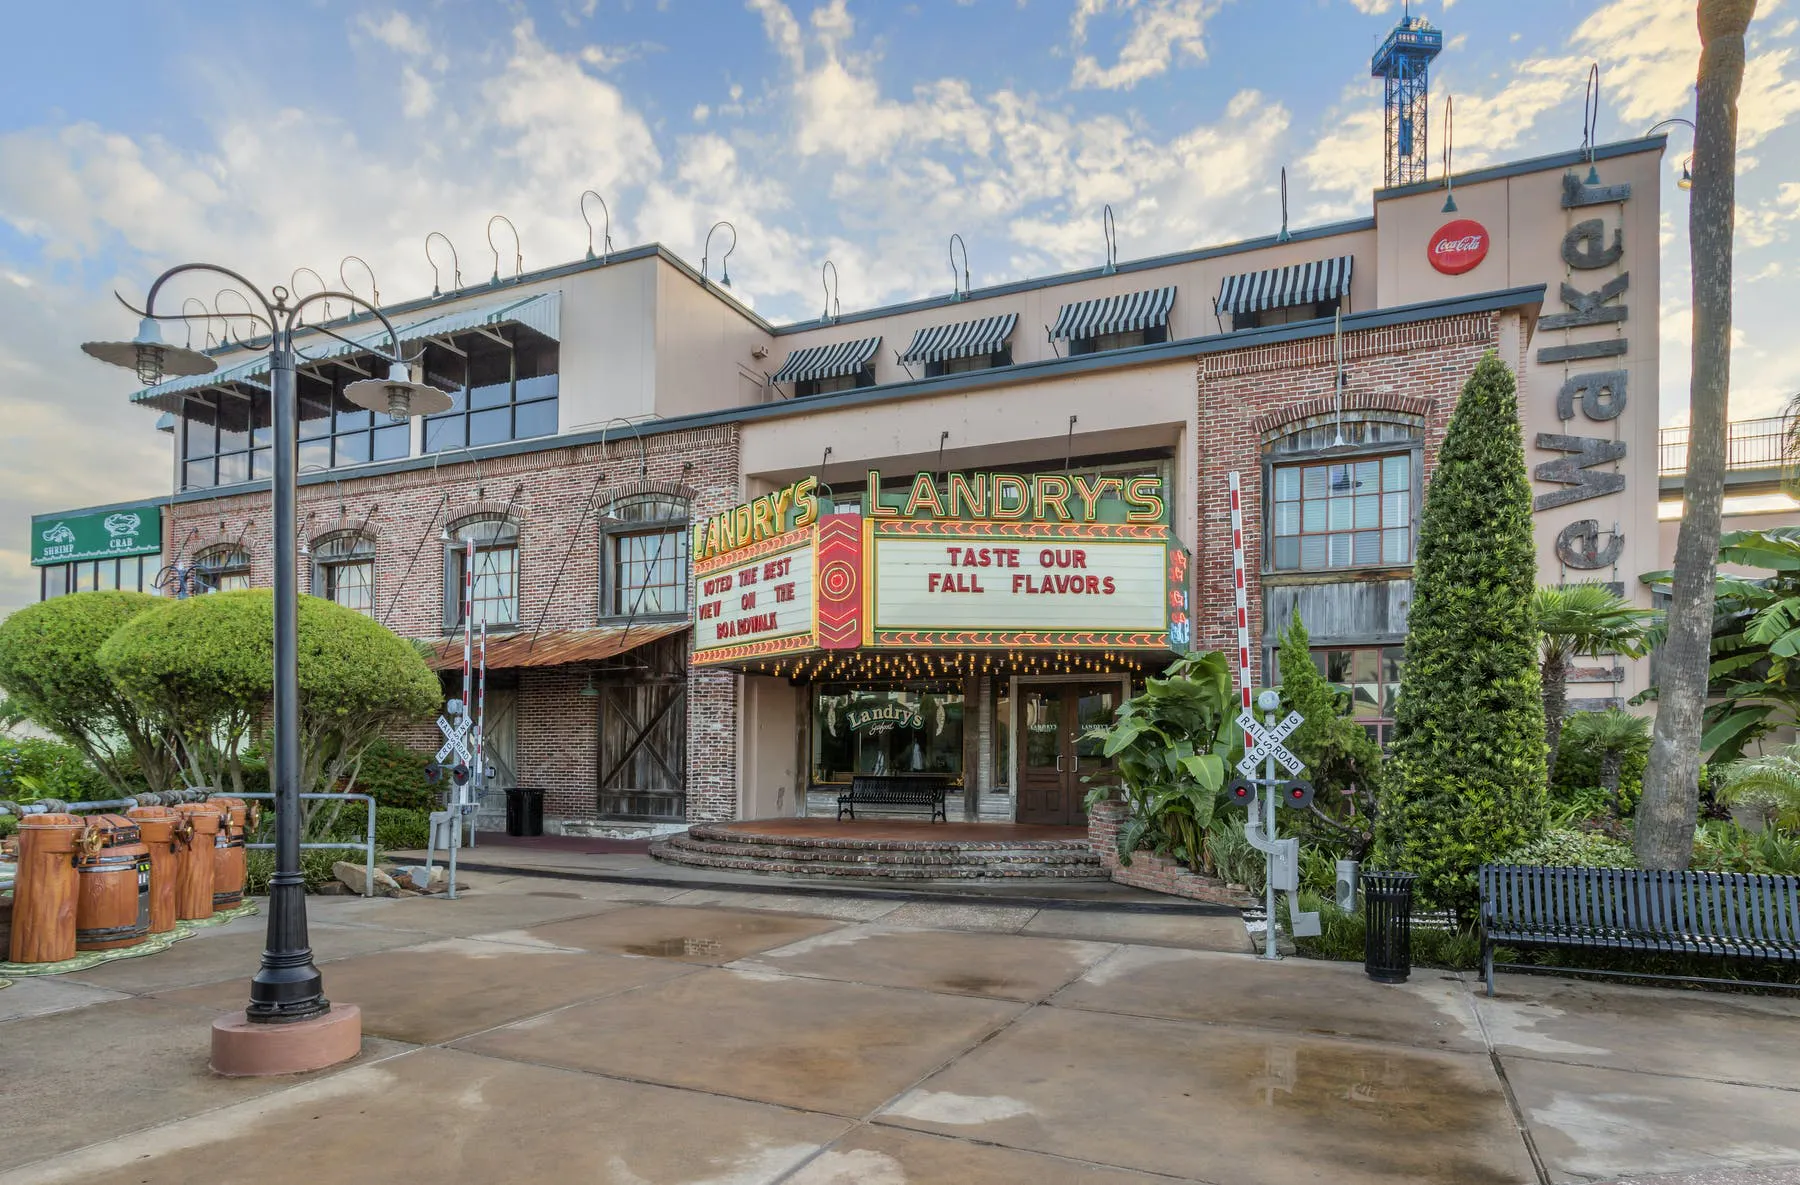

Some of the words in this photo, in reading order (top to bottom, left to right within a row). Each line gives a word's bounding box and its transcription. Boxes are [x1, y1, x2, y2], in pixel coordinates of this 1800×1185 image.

[868, 470, 1165, 522] LANDRY'S
[693, 475, 818, 562] LANDRY'S
[43, 543, 75, 556] SHRIMP
[109, 537, 133, 548] CRAB
[946, 547, 1020, 568] TASTE
[1039, 549, 1087, 569] OUR
[703, 575, 733, 597] VOTED
[738, 566, 758, 588] THE
[763, 557, 792, 582] BEST
[928, 573, 984, 593] FALL
[1012, 574, 1116, 595] FLAVORS
[698, 600, 721, 620] VIEW
[741, 591, 756, 611] ON
[774, 581, 795, 603] THE
[716, 611, 778, 640] BOARDWALK
[848, 703, 923, 729] Landry's
[439, 719, 470, 760] CROSSING
[1241, 715, 1299, 770] CROSSING
